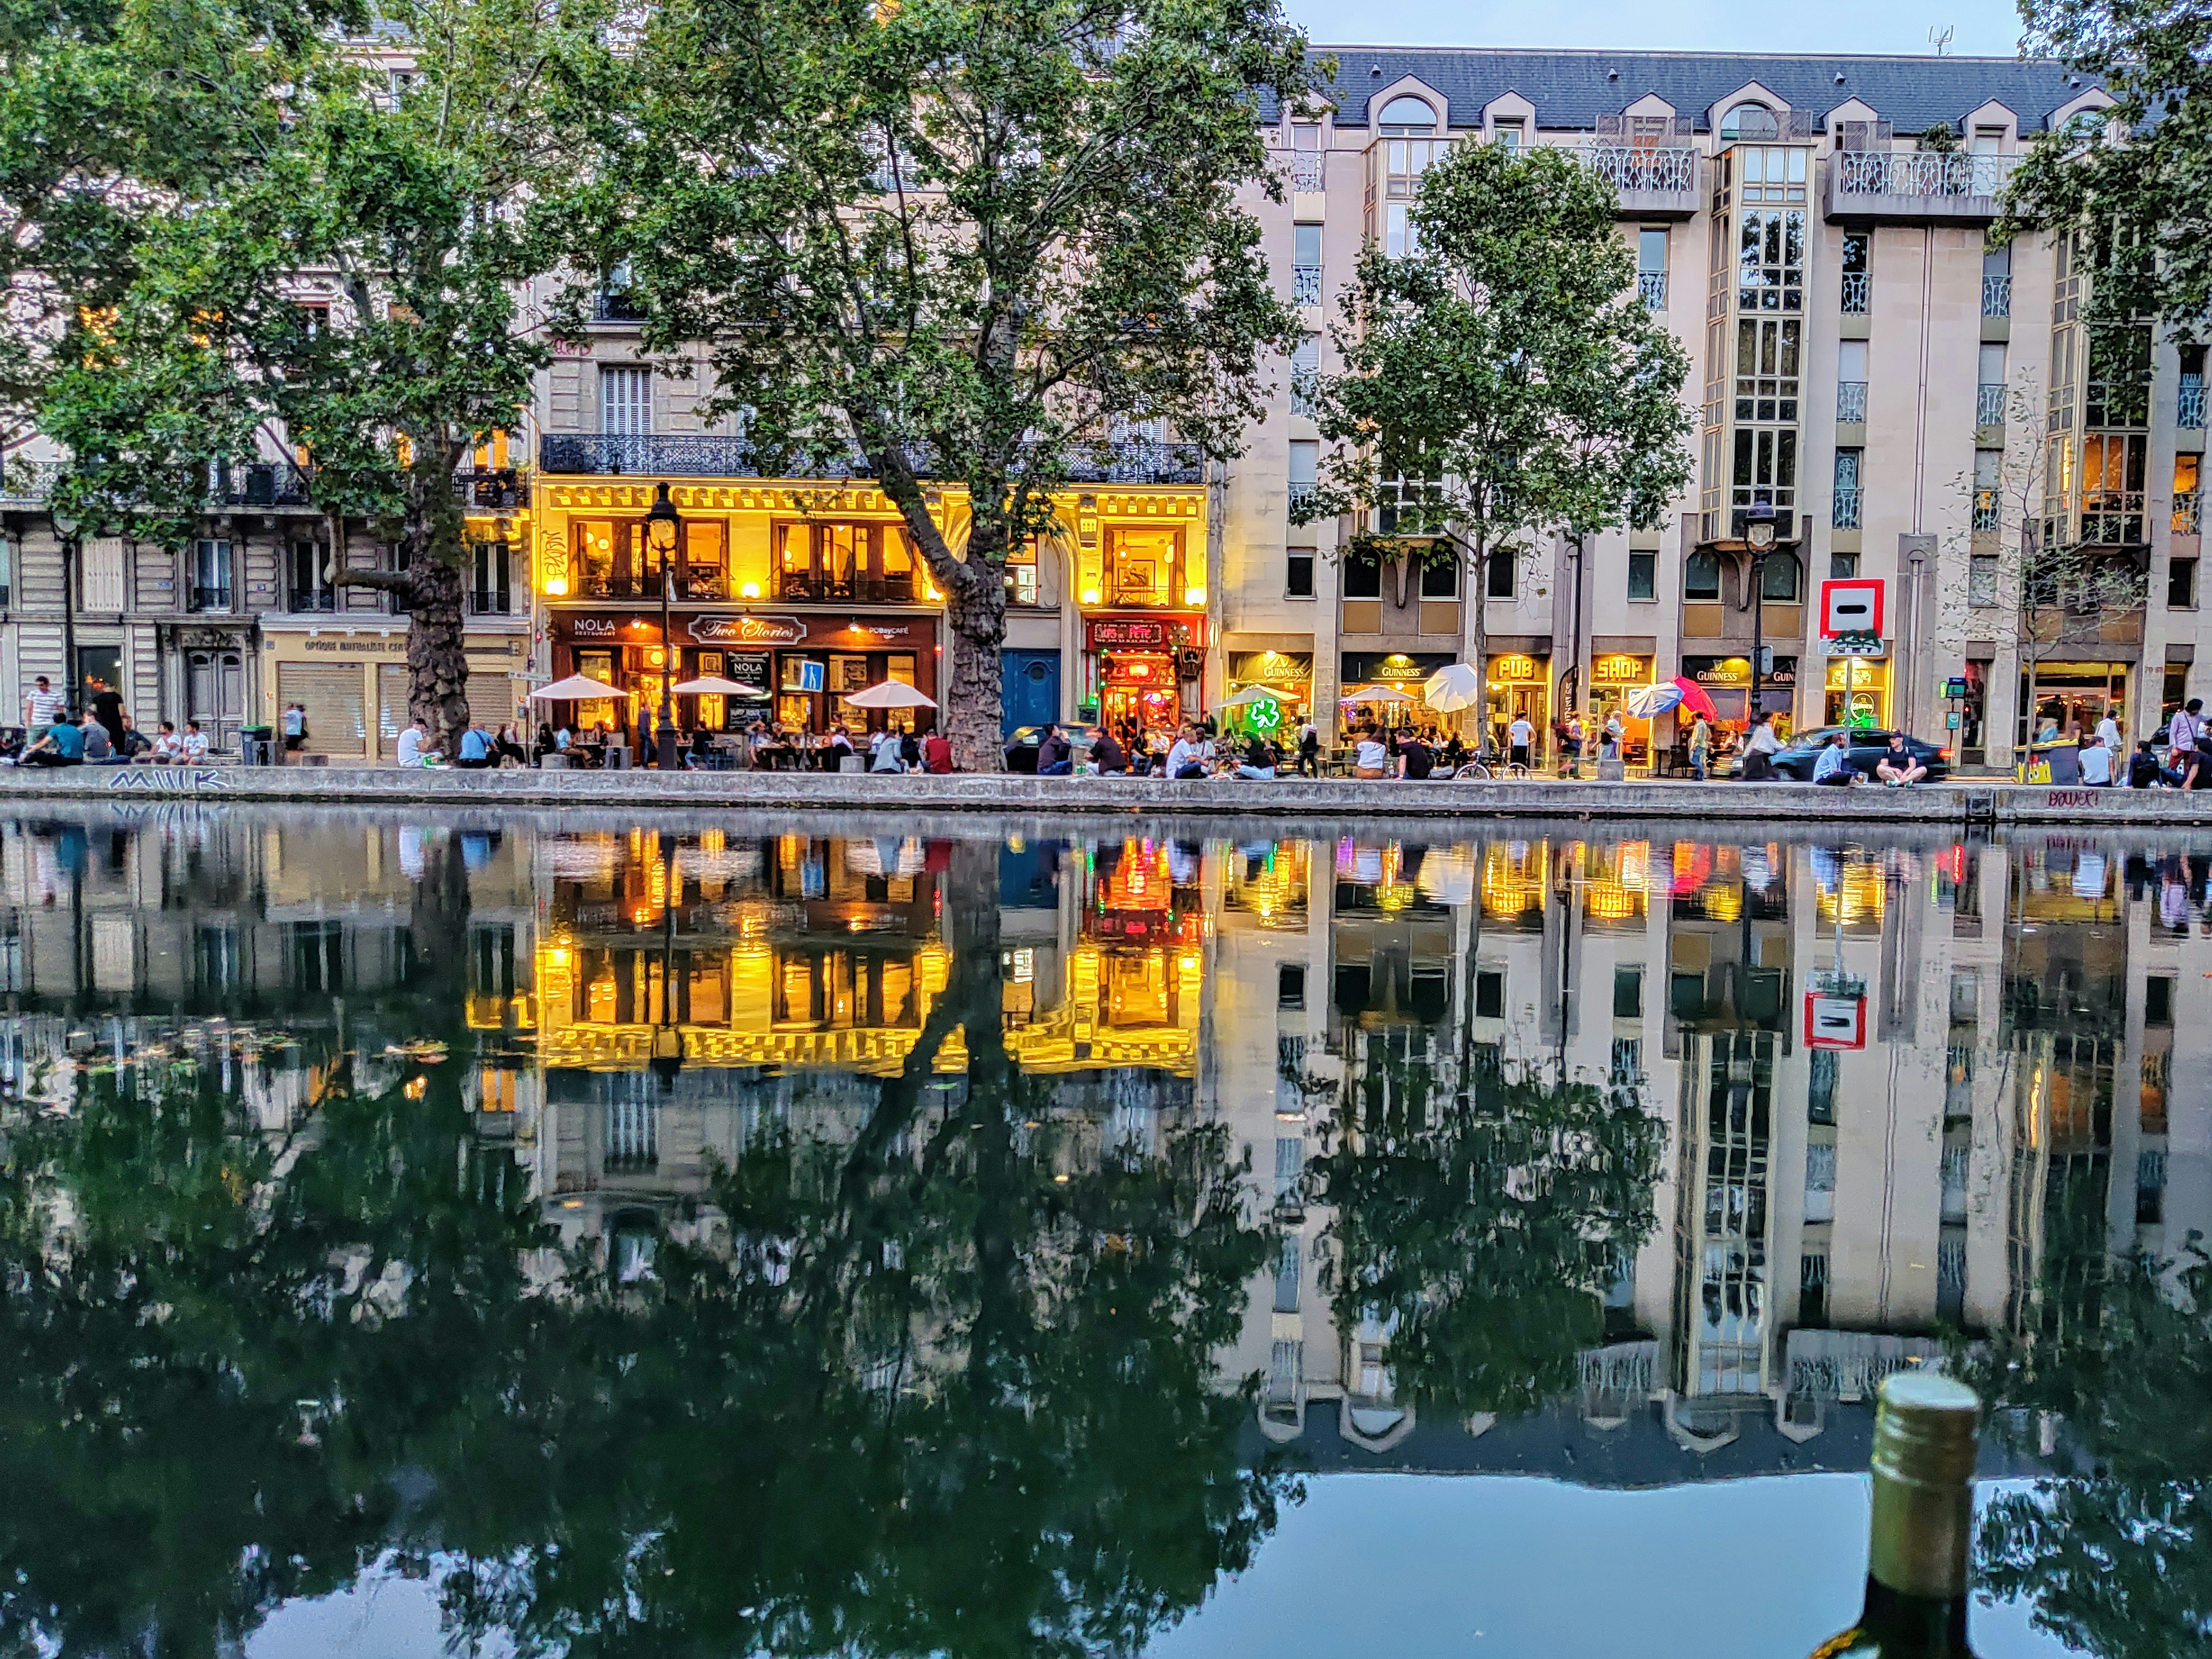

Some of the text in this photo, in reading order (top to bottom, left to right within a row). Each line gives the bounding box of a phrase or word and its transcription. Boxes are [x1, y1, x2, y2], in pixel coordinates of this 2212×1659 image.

[574, 619, 615, 631] NOLA
[699, 619, 794, 640] Two Stories
[734, 662, 763, 672] NOLA
[1264, 666, 1304, 677] GUINNESS
[1381, 667, 1422, 677] GUINNESS
[1498, 660, 1534, 678] PUB
[1597, 660, 1643, 679] SHOP
[1697, 670, 1739, 681] GUINNESS
